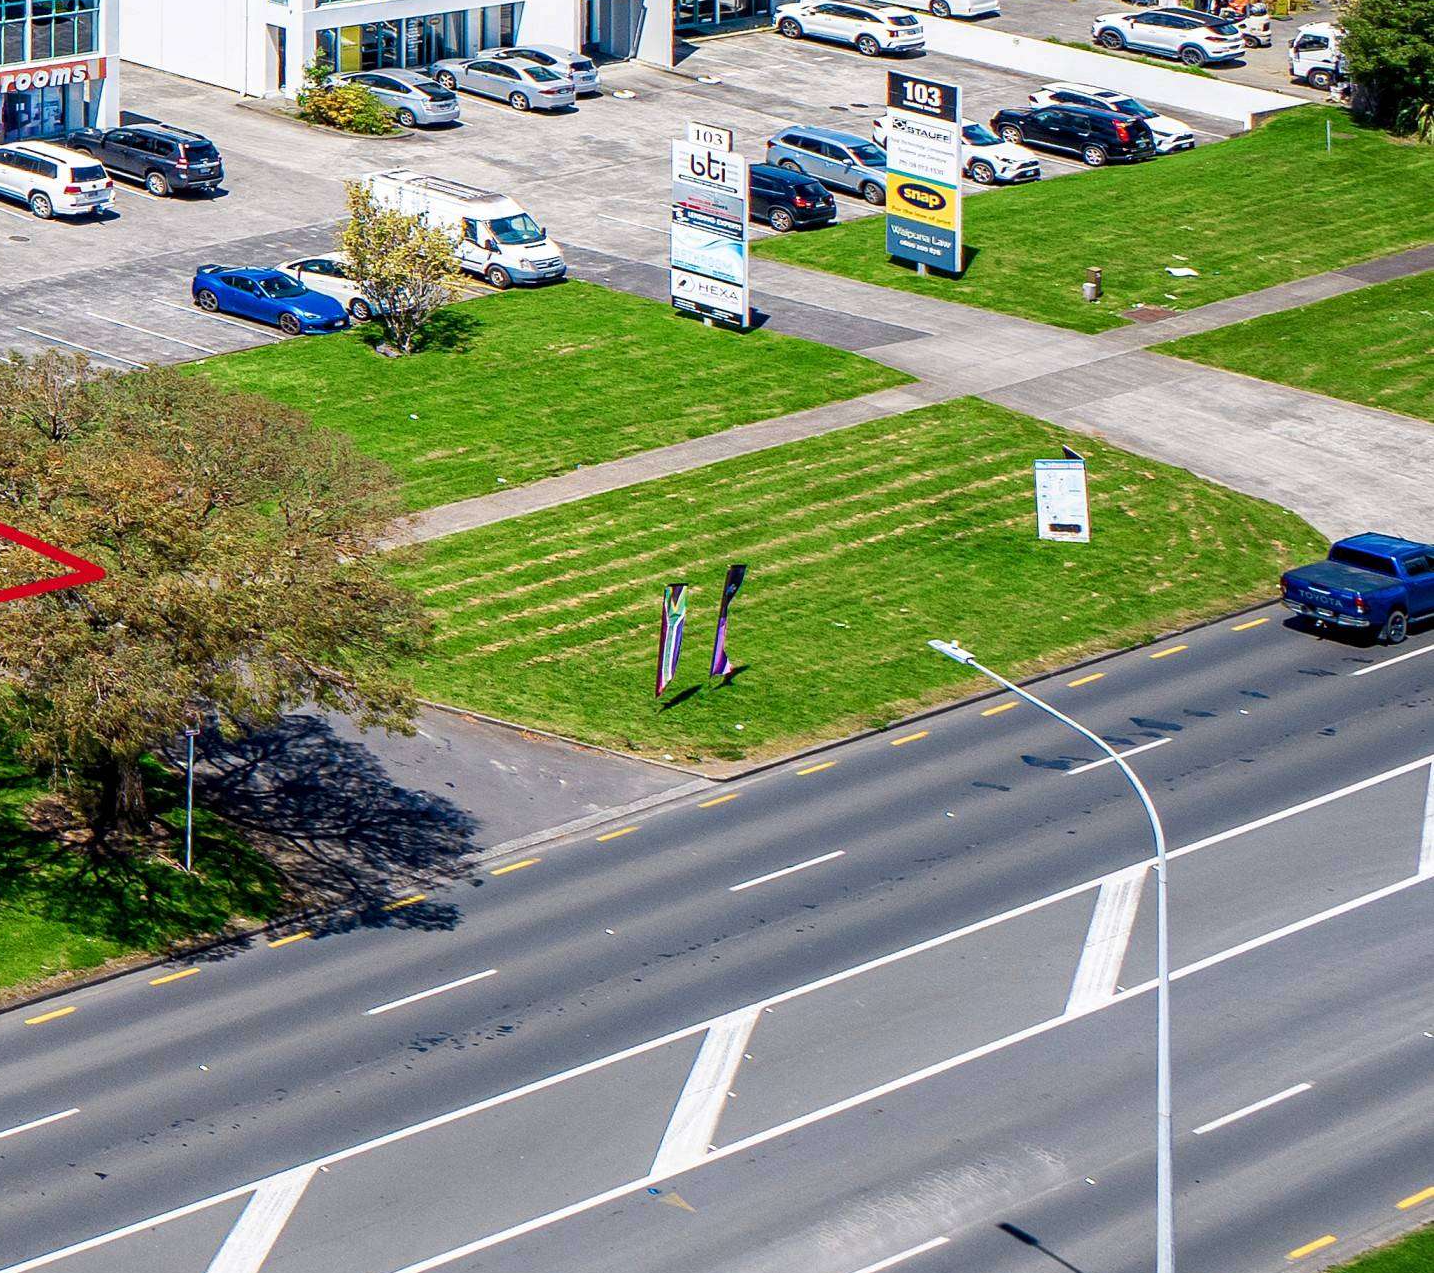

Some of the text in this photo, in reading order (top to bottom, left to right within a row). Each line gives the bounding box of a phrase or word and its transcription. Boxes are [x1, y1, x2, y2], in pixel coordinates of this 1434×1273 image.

[903, 81, 941, 106] 103
[697, 130, 722, 144] 103
[907, 126, 949, 141] STAUFF
[691, 151, 726, 183] bti
[903, 188, 941, 207] snap
[931, 236, 951, 248] Law
[699, 283, 738, 300] HEXA
[1298, 589, 1342, 608] TOYOTA
